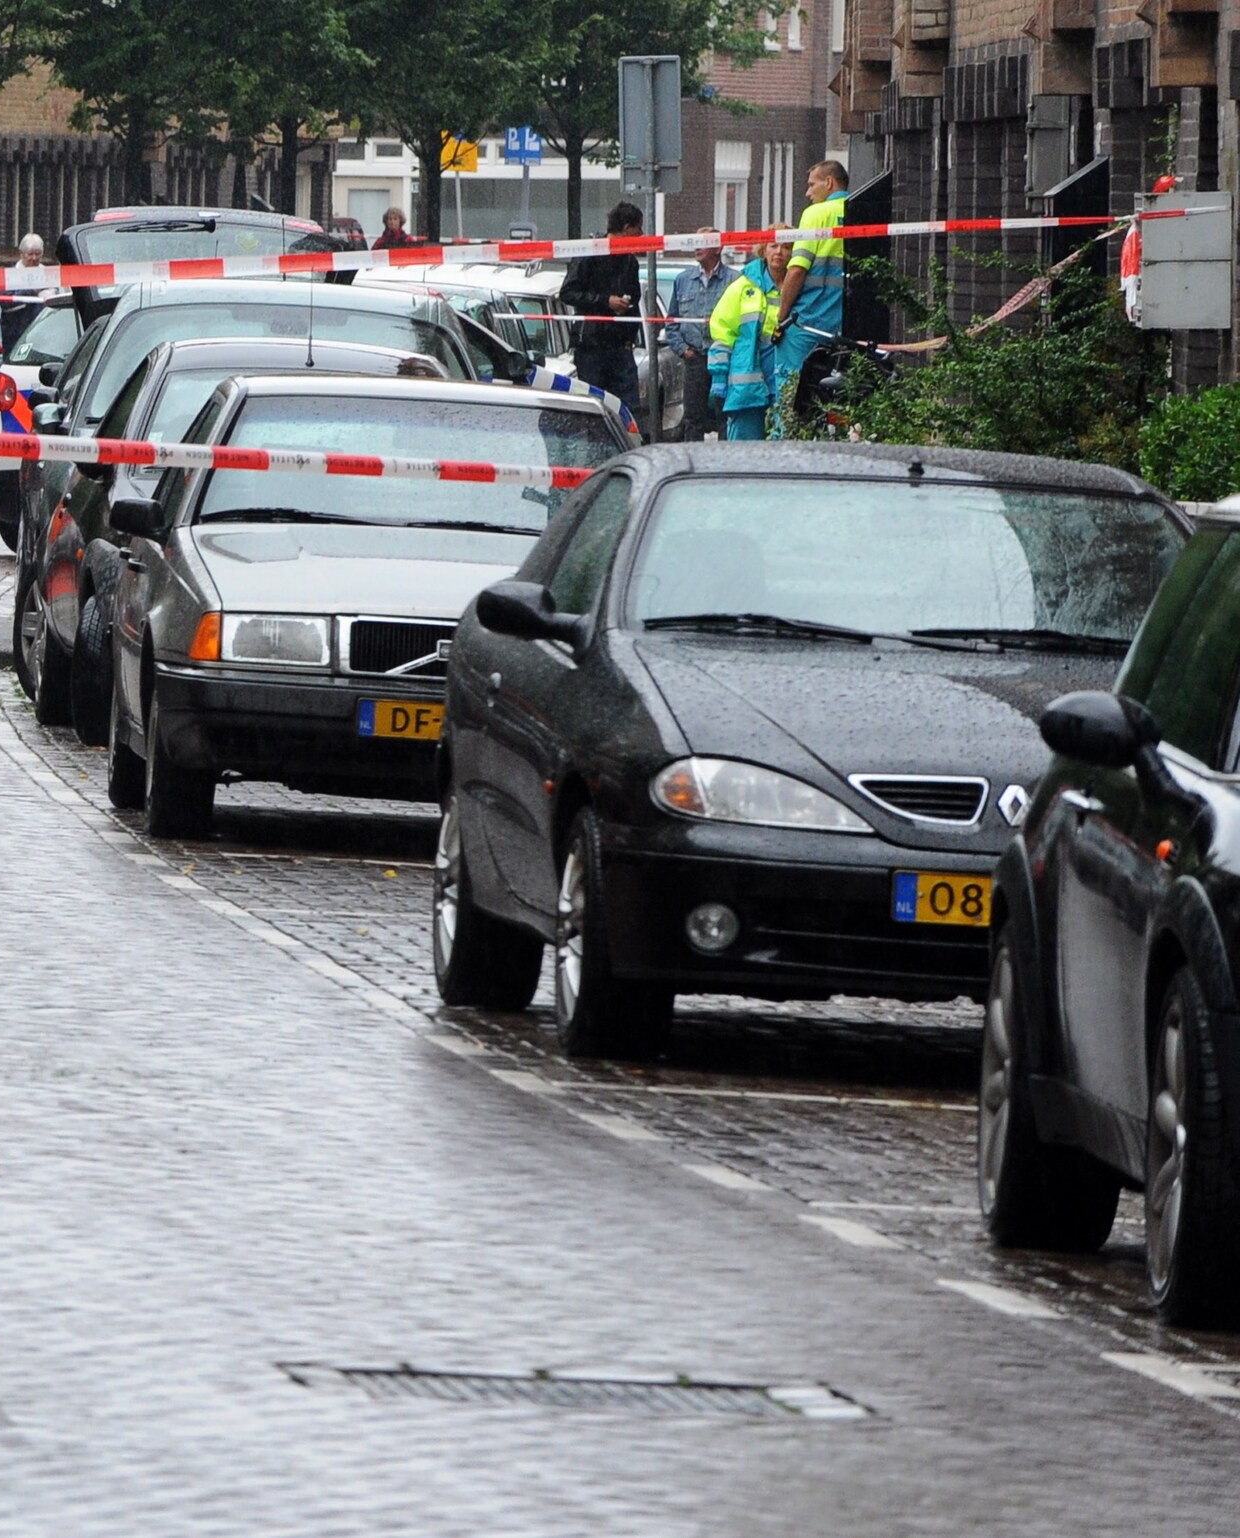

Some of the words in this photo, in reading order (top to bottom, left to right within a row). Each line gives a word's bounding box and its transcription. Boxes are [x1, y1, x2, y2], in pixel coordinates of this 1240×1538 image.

[49, 443, 91, 453] BETREDEN
[929, 882, 984, 918] 08
[896, 901, 914, 914] NL
